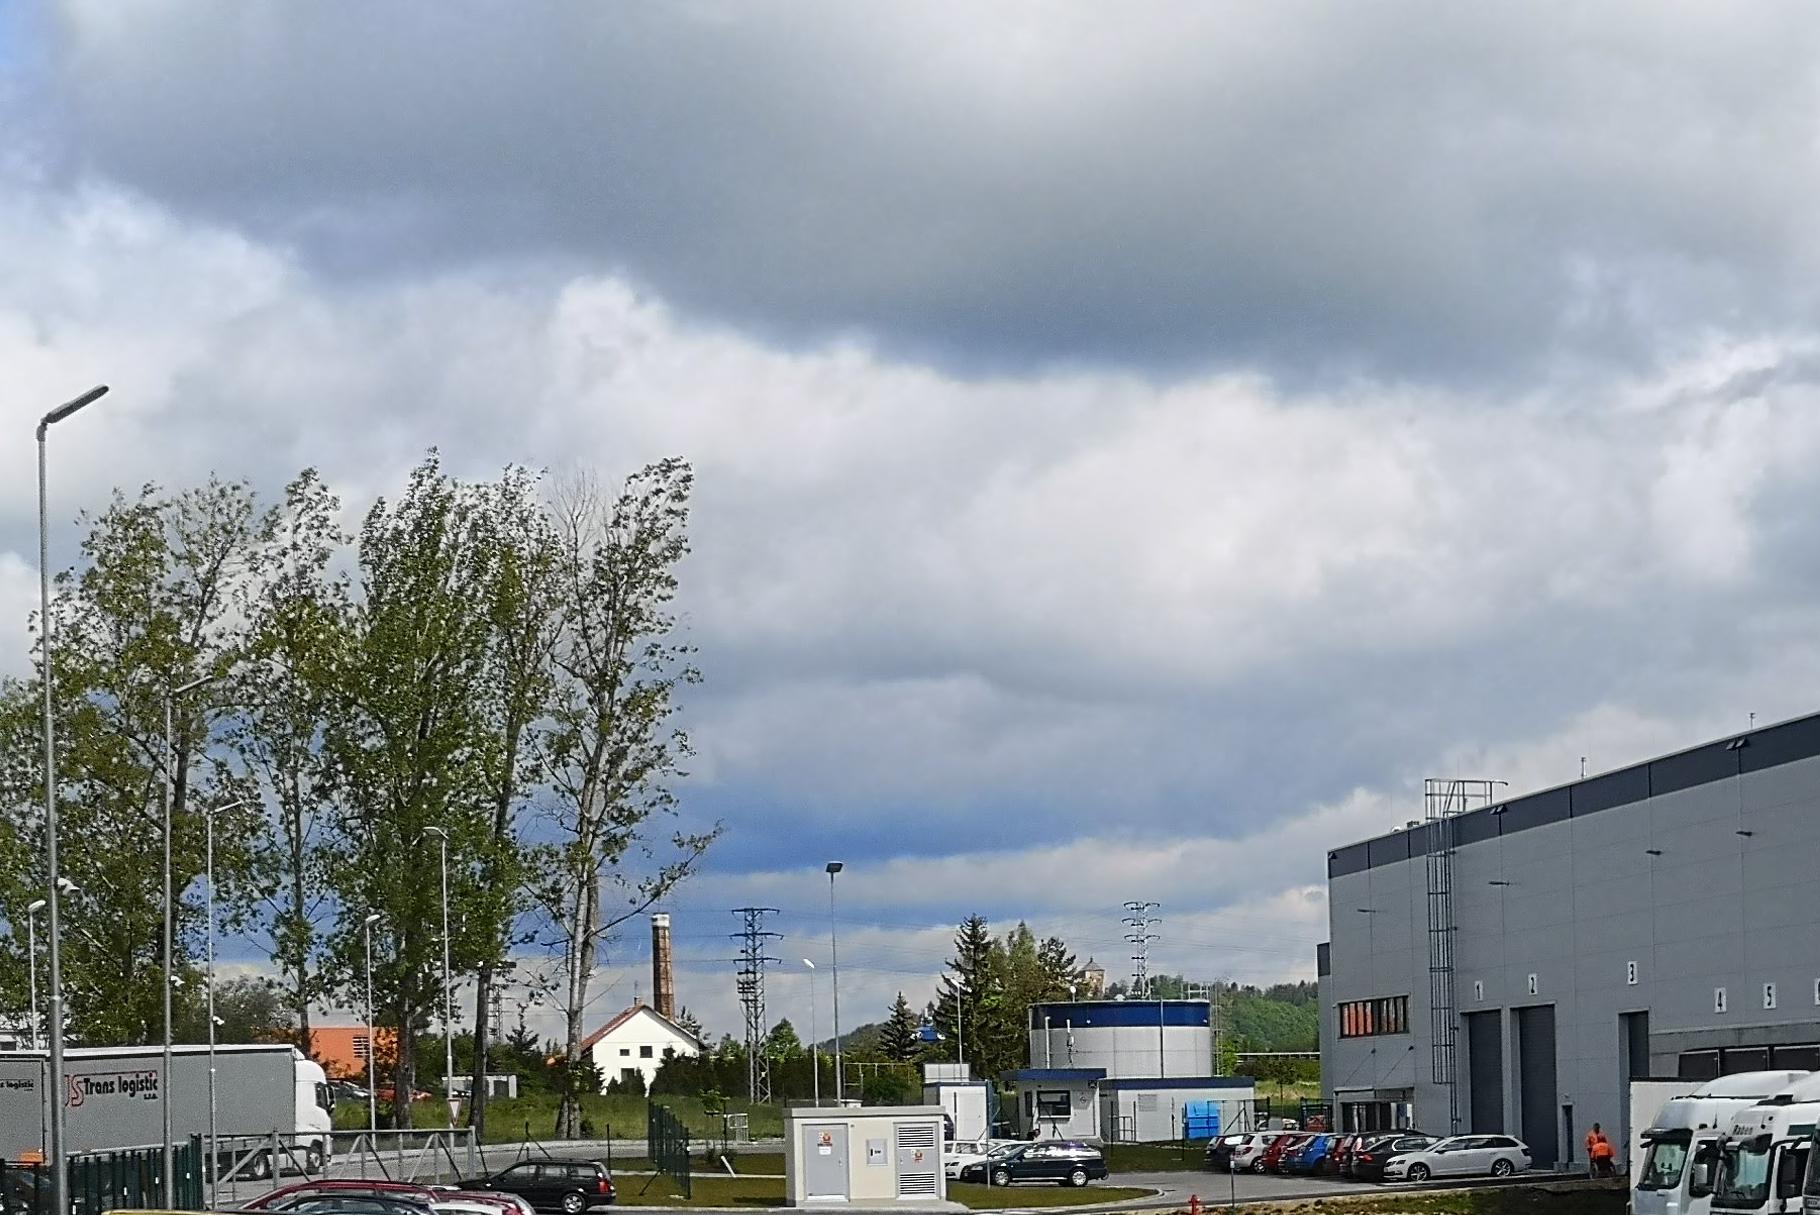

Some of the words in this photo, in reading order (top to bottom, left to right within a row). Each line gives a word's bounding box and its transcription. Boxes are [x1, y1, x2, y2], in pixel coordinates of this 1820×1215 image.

[1629, 963, 1636, 982] 3
[1717, 991, 1723, 1010] 4
[1766, 985, 1773, 1006] 5
[84, 1077, 115, 1095] Trans
[118, 1072, 158, 1097] logistic
